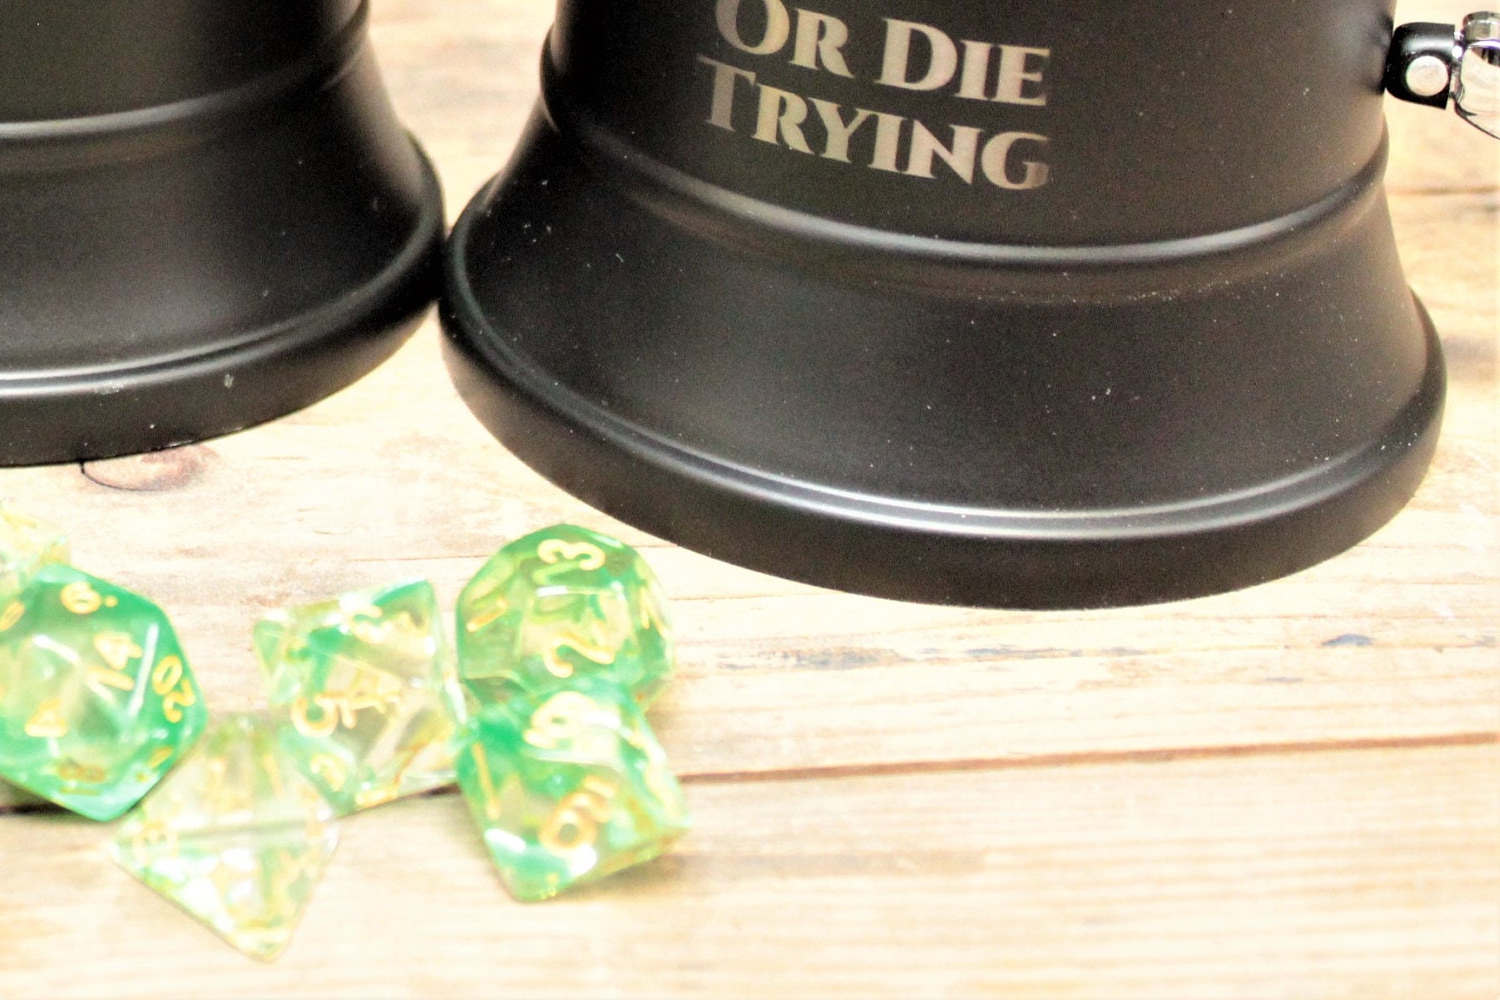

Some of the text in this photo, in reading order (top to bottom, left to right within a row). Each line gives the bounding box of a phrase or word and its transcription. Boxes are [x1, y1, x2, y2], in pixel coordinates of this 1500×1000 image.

[874, 16, 1051, 107] DIE
[696, 52, 1051, 191] TRYING
[152, 655, 197, 723] 20
